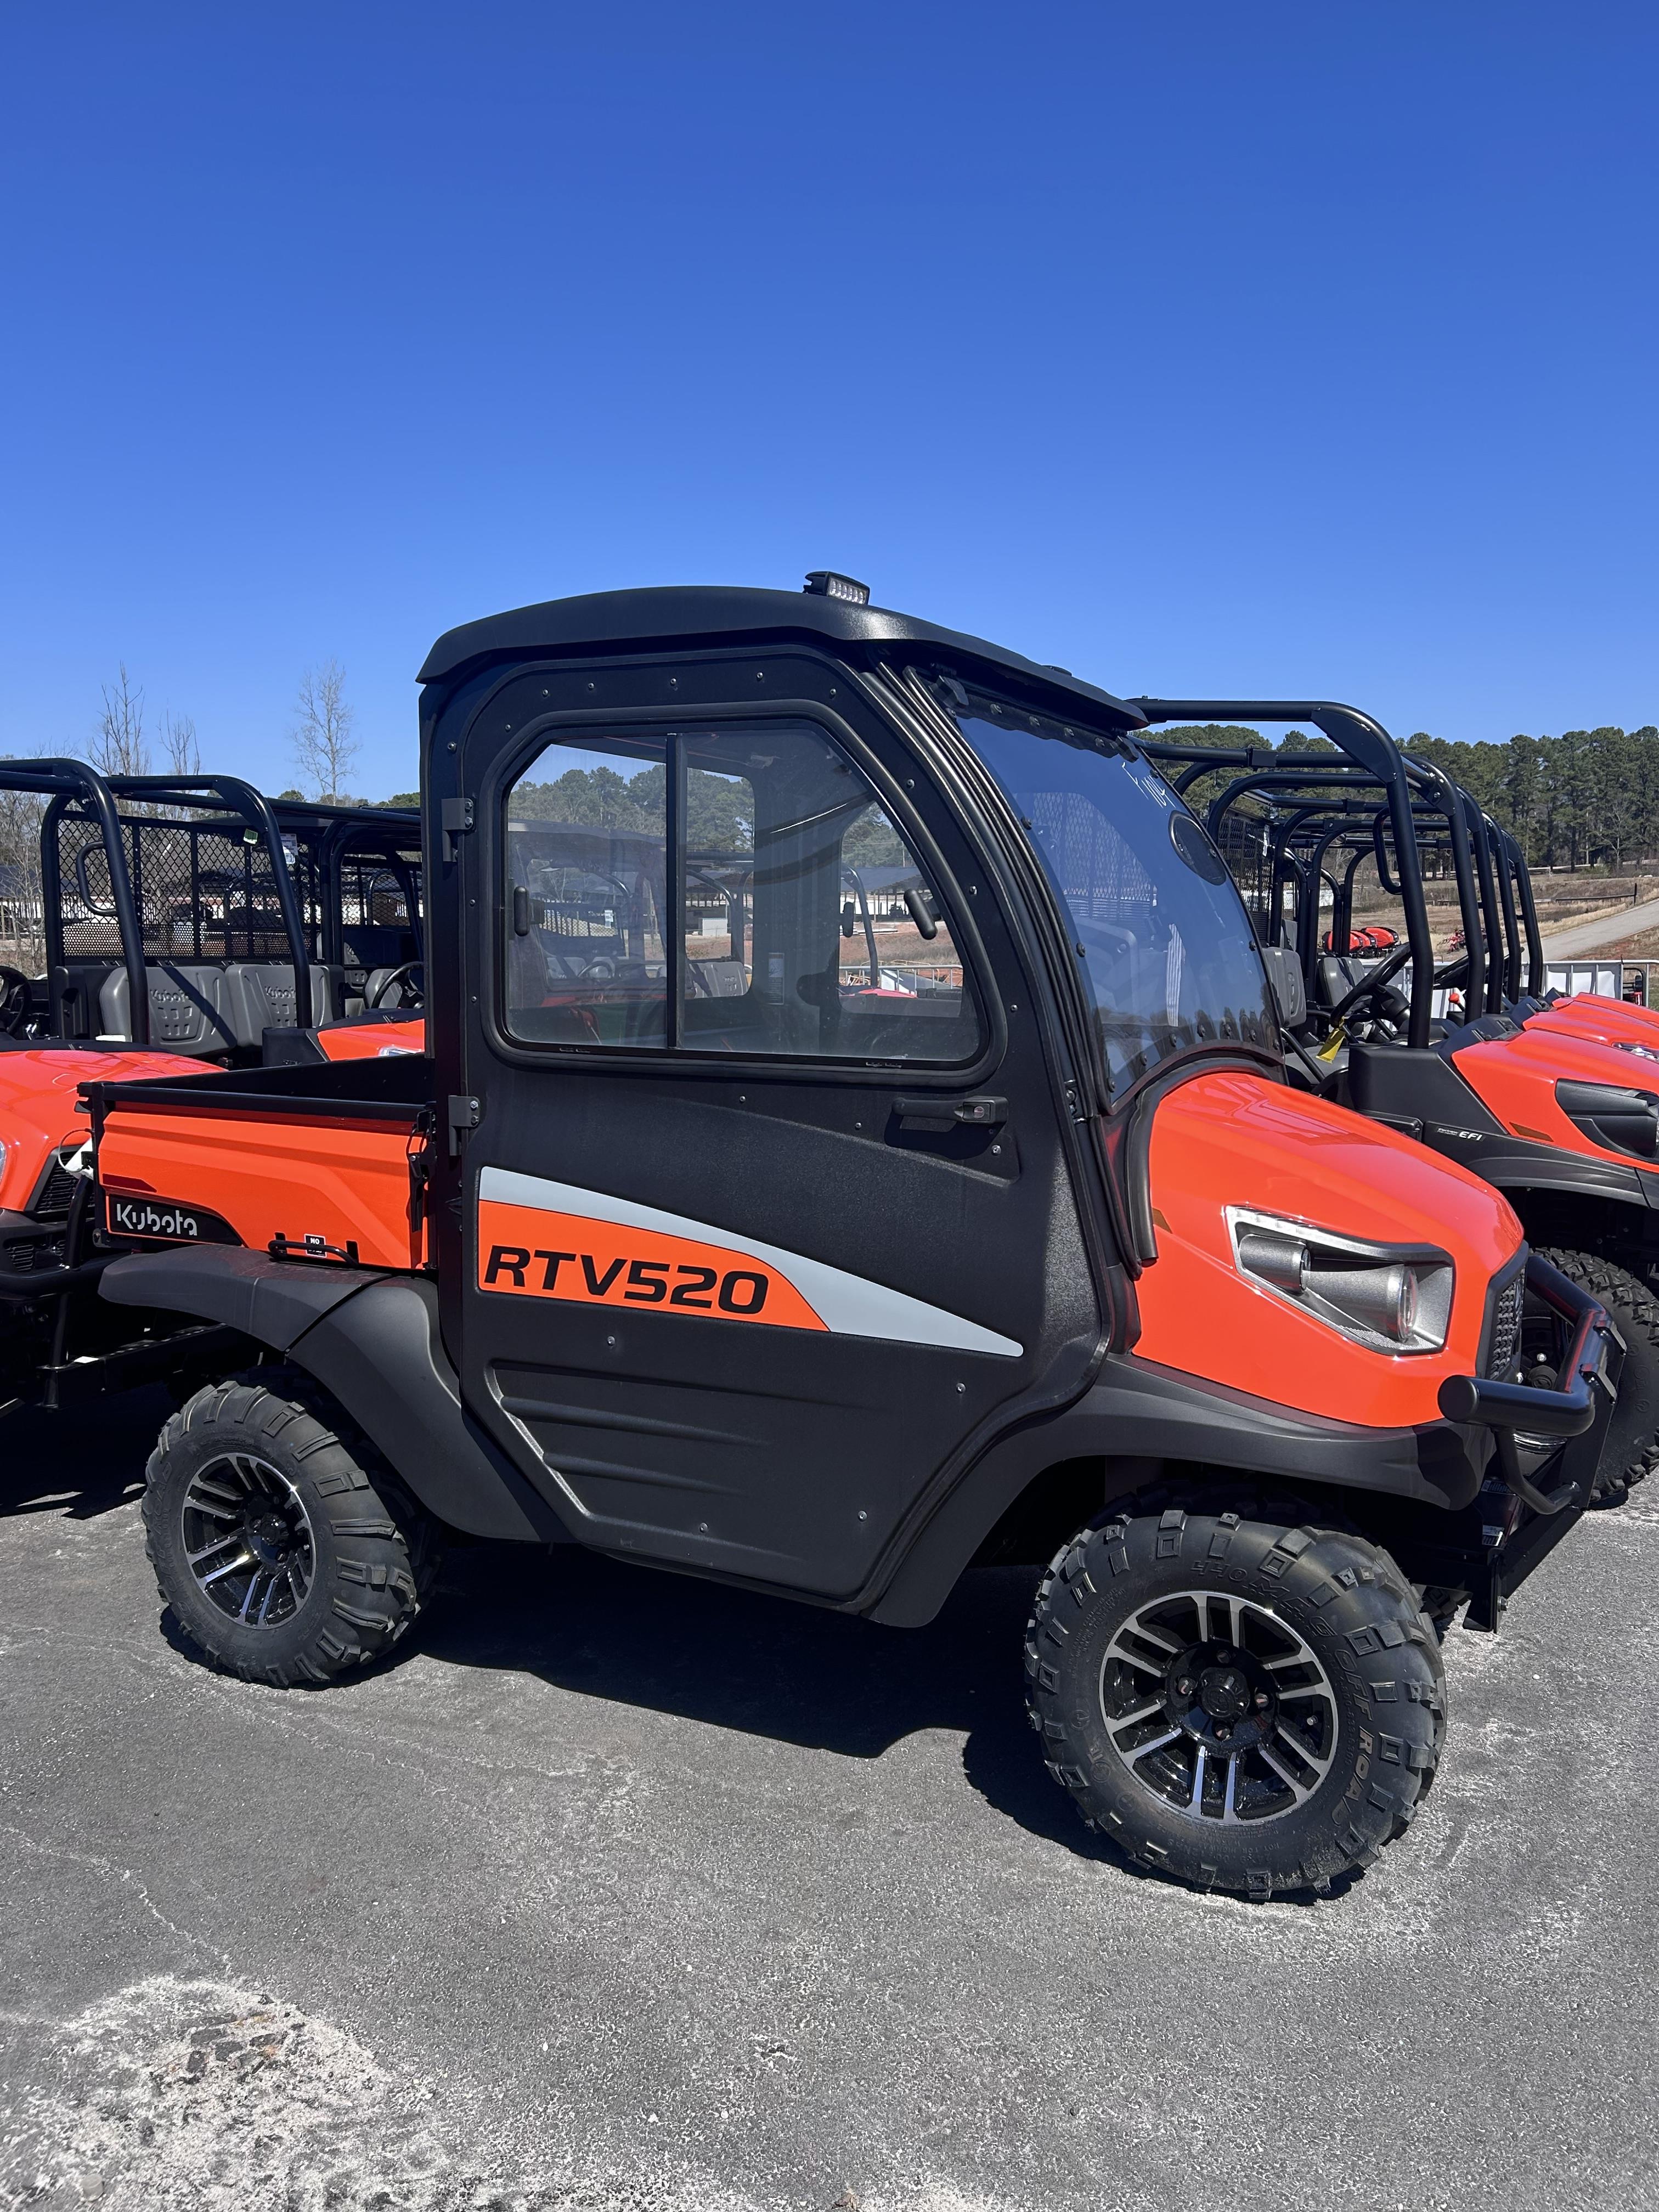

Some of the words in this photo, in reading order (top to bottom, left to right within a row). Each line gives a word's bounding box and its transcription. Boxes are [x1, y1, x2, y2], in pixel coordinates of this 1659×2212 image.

[265, 986, 296, 999] Kubot
[1459, 1131, 1482, 1141] EFI
[116, 1203, 198, 1236] Kubota
[484, 1245, 769, 1314] RTV520
[1248, 1575, 1338, 1637] MAG
[1335, 1649, 1374, 1722] OFF
[1331, 1725, 1375, 1826] ROAD
